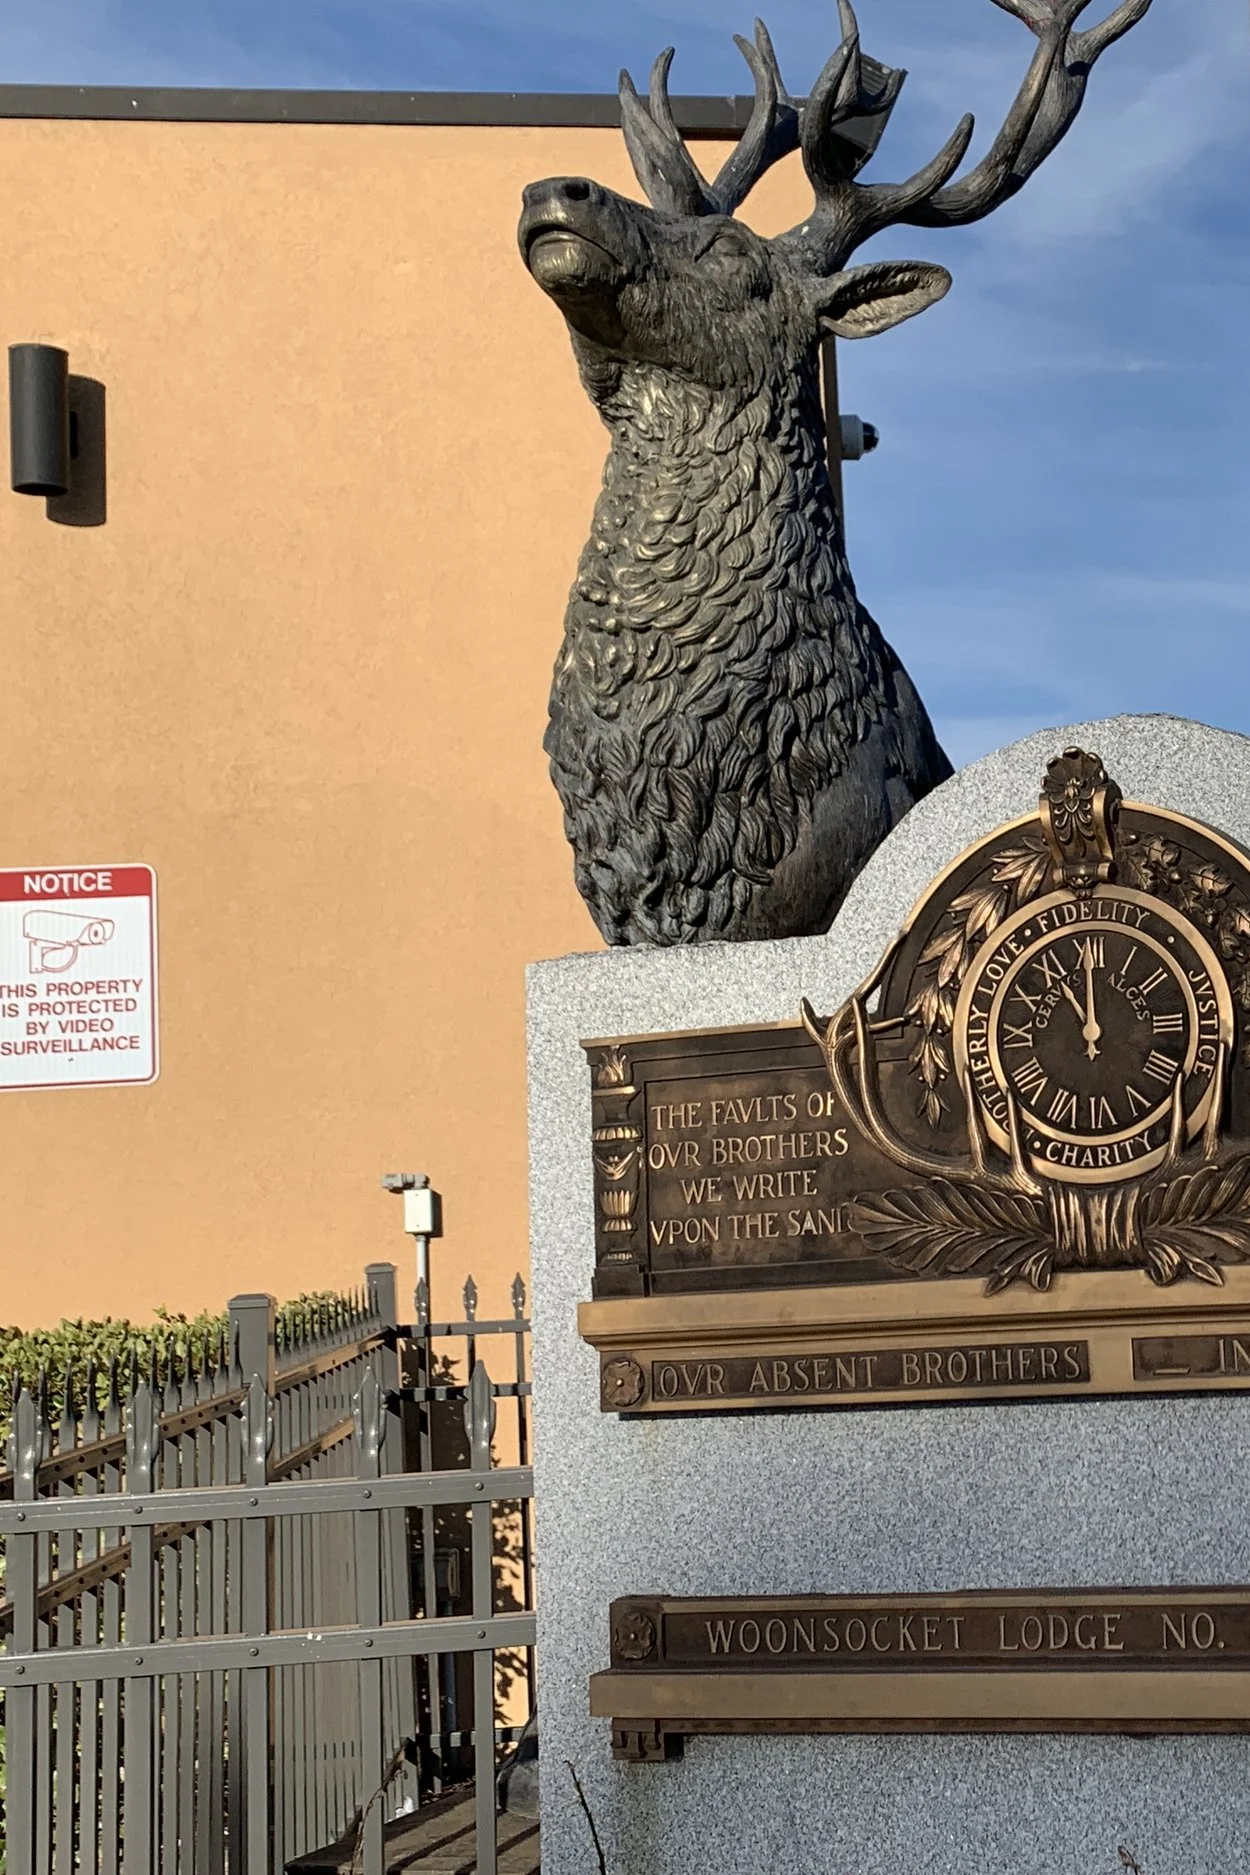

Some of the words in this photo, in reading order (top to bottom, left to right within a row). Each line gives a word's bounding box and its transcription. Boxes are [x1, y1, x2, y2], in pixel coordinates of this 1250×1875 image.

[23, 871, 112, 894] NOTICE
[1036, 901, 1150, 933] FIDELITY
[978, 934, 1025, 997] LOVE
[0, 983, 37, 998] THIS
[46, 978, 144, 997] PROPERTY
[1107, 972, 1150, 1020] ALCES
[2, 1003, 19, 1018] IS
[28, 998, 137, 1017] PROTECTED
[1188, 970, 1218, 1078] JVSTICE
[25, 1020, 49, 1036] BY
[59, 1017, 114, 1035] VIDEO
[0, 1035, 140, 1056] SURVEILLANCE
[651, 1102, 703, 1131] THE
[710, 1094, 798, 1126] FAVLTS
[649, 1140, 701, 1170] OVR
[712, 1128, 849, 1165] BROTHERS
[1046, 1130, 1152, 1167] CHARITY
[680, 1177, 722, 1204] WE
[732, 1169, 818, 1200] WRITE
[650, 1217, 719, 1245] VPON
[728, 1212, 780, 1241] THE
[659, 1362, 727, 1398] OVR
[748, 1355, 878, 1394] ABSENT
[902, 1345, 1083, 1386] BROTHERS
[704, 1615, 966, 1654] WOONSOCKET
[998, 1613, 1126, 1651] LODGE
[1161, 1611, 1225, 1650] NO.
